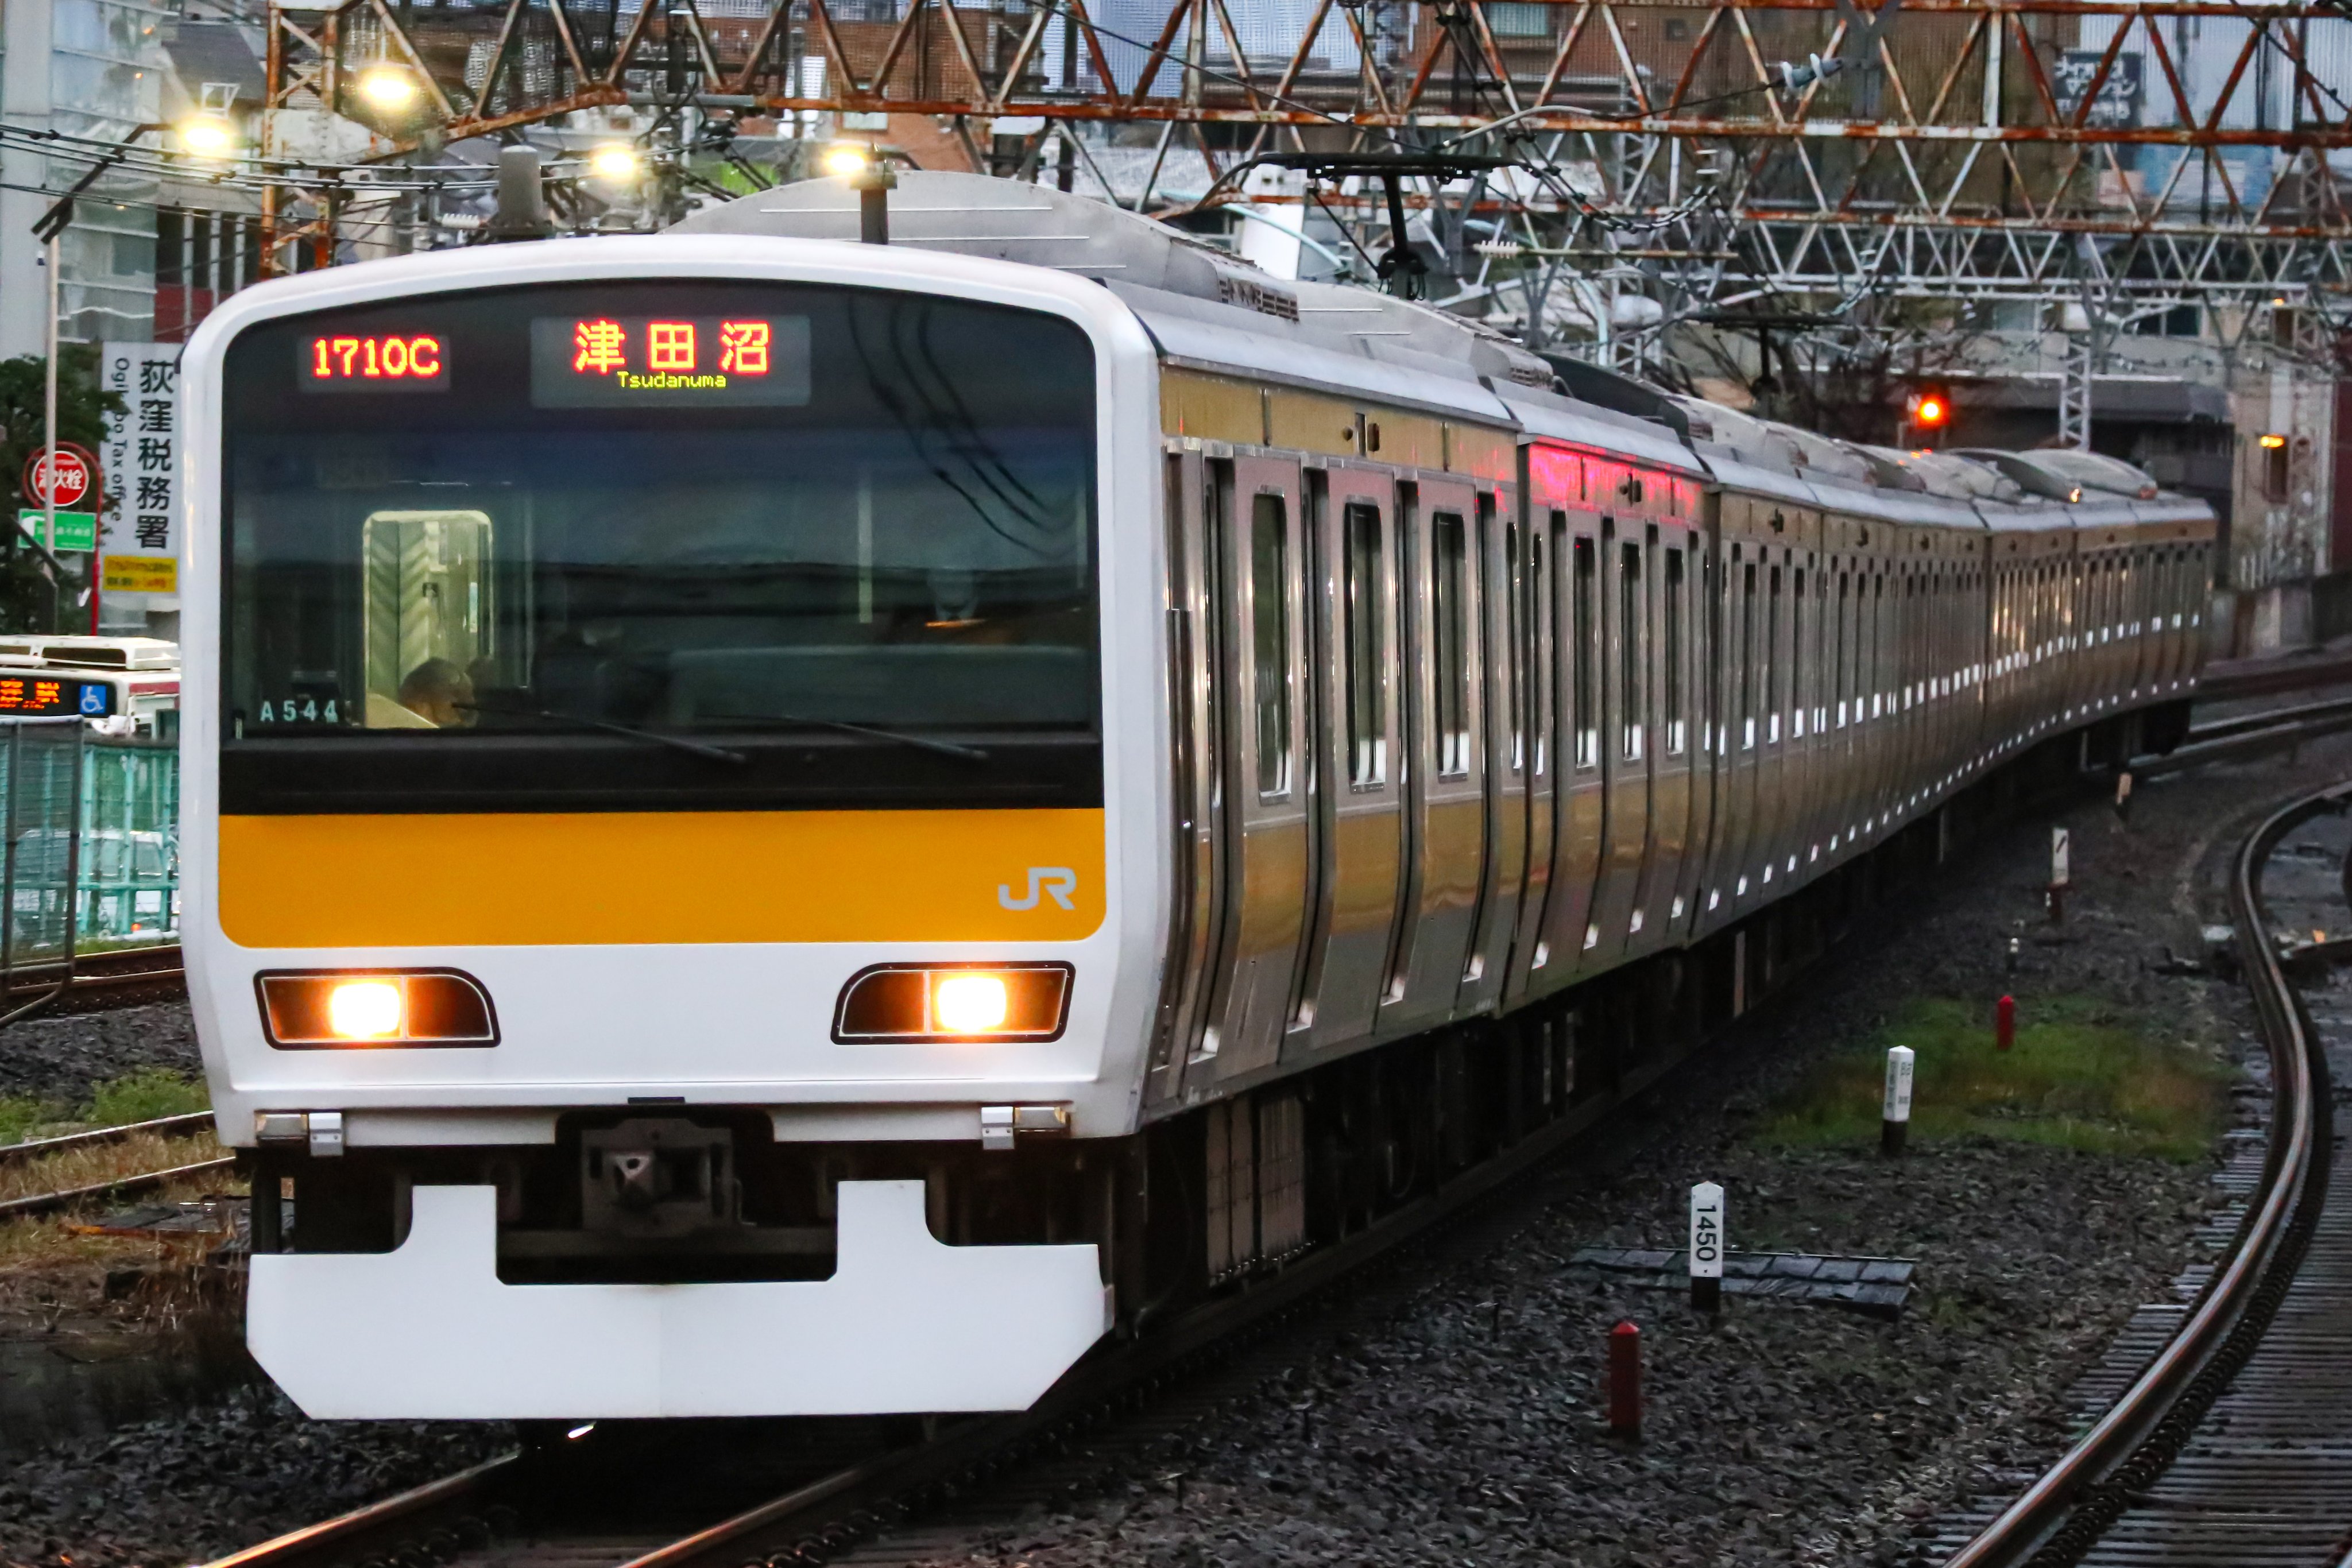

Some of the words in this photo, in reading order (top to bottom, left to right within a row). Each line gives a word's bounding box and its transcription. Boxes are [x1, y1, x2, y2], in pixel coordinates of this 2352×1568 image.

[313, 338, 440, 378] 1710C
[575, 320, 768, 374] 津田沼
[617, 370, 726, 388] Tsudanuma
[112, 439, 127, 469] Tax
[136, 358, 175, 549] 荻窪税務署
[998, 867, 1077, 910] JR
[1696, 1205, 1717, 1261] 1450
